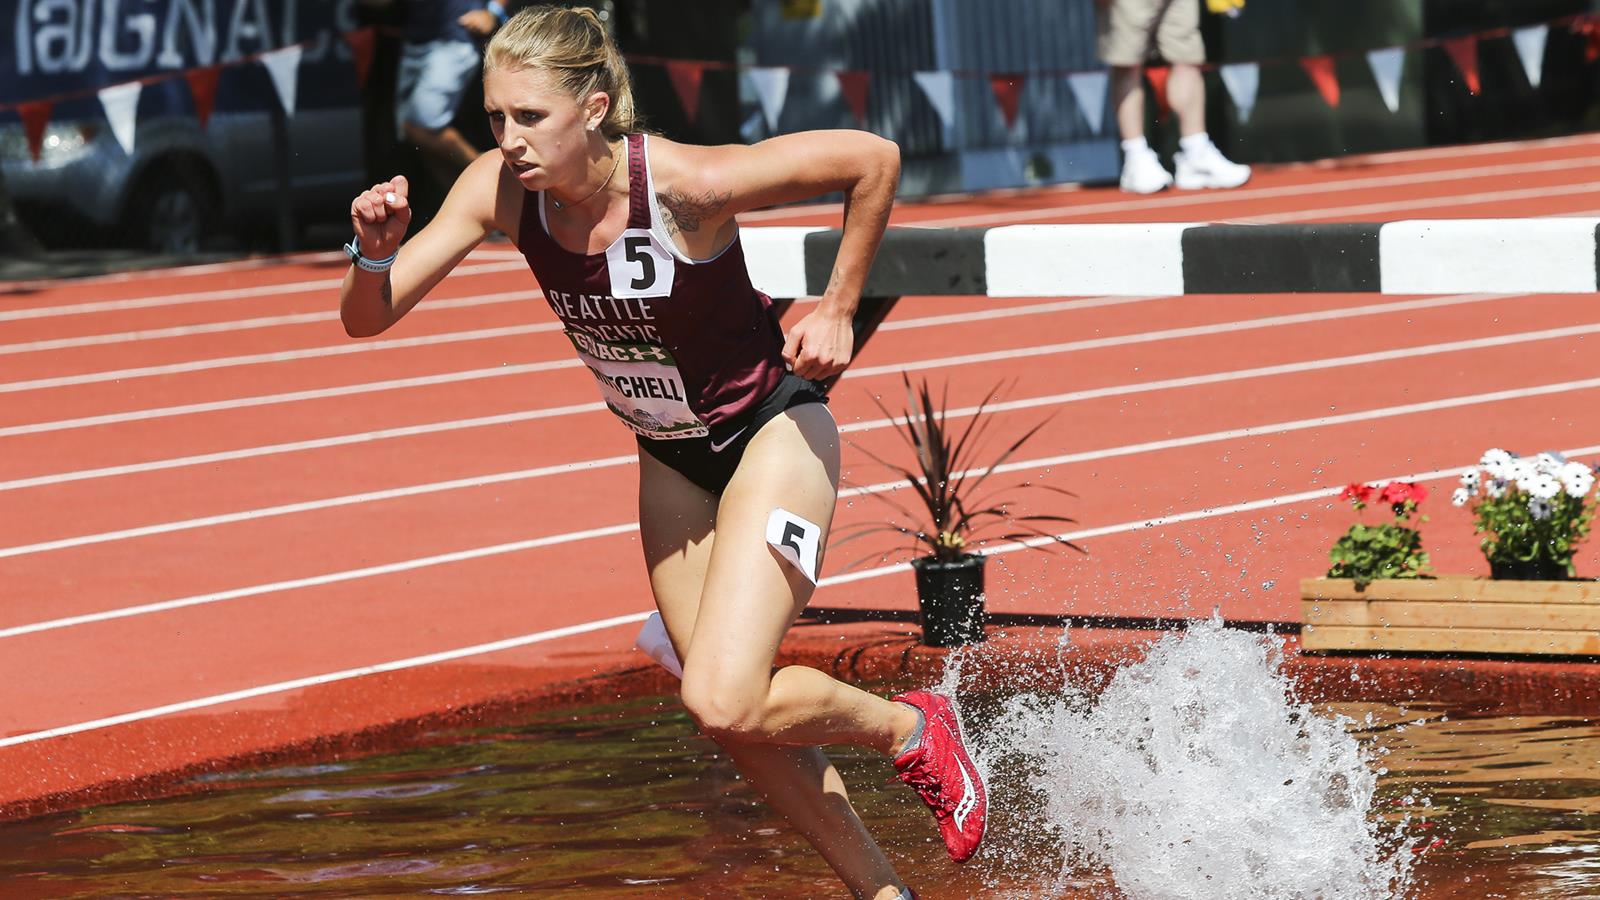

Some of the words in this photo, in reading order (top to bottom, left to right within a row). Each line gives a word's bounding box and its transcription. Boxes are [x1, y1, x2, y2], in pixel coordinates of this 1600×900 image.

[624, 236, 656, 290] 5
[549, 289, 655, 320] SEATTLE
[572, 332, 630, 361] GNAC
[781, 520, 805, 560] 5
